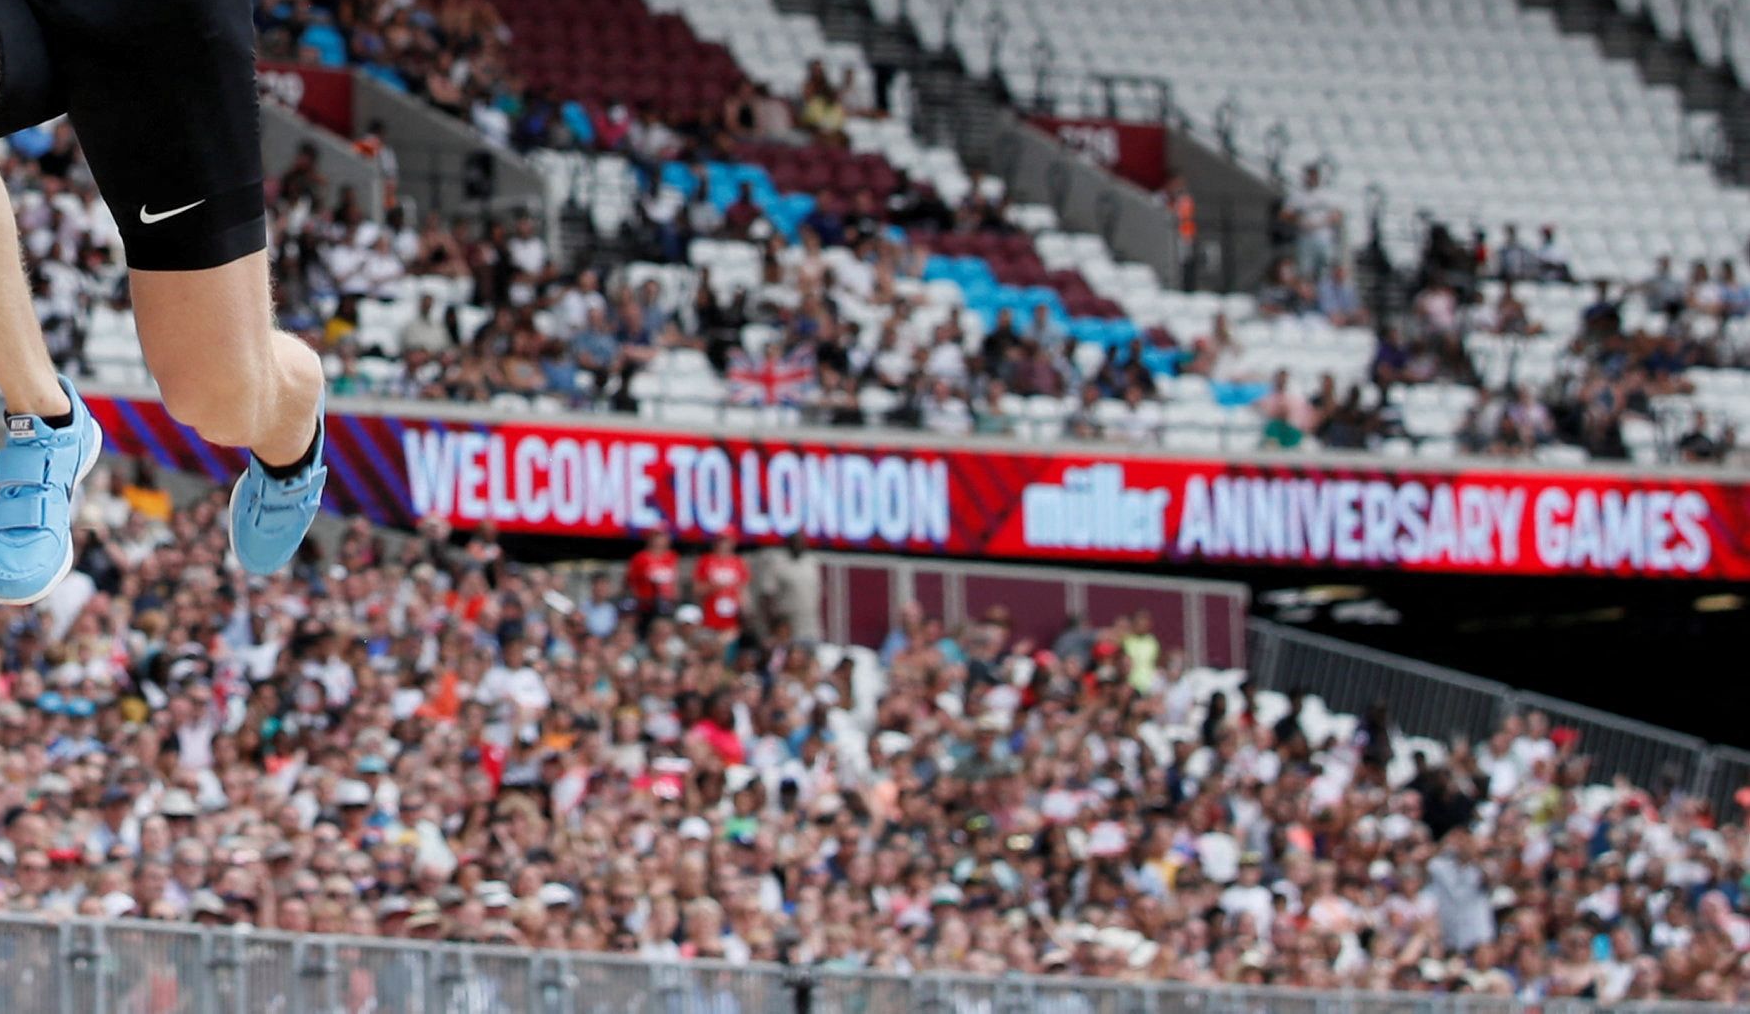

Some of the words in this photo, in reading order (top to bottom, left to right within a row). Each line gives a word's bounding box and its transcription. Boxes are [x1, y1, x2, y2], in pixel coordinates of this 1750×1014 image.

[11, 419, 30, 430] NIKE
[403, 428, 663, 528] WELCOME
[665, 444, 733, 533] TO
[740, 449, 949, 544] LONDON
[1177, 473, 1527, 566] ANNIVERSARY
[1534, 485, 1712, 573] GAMES
